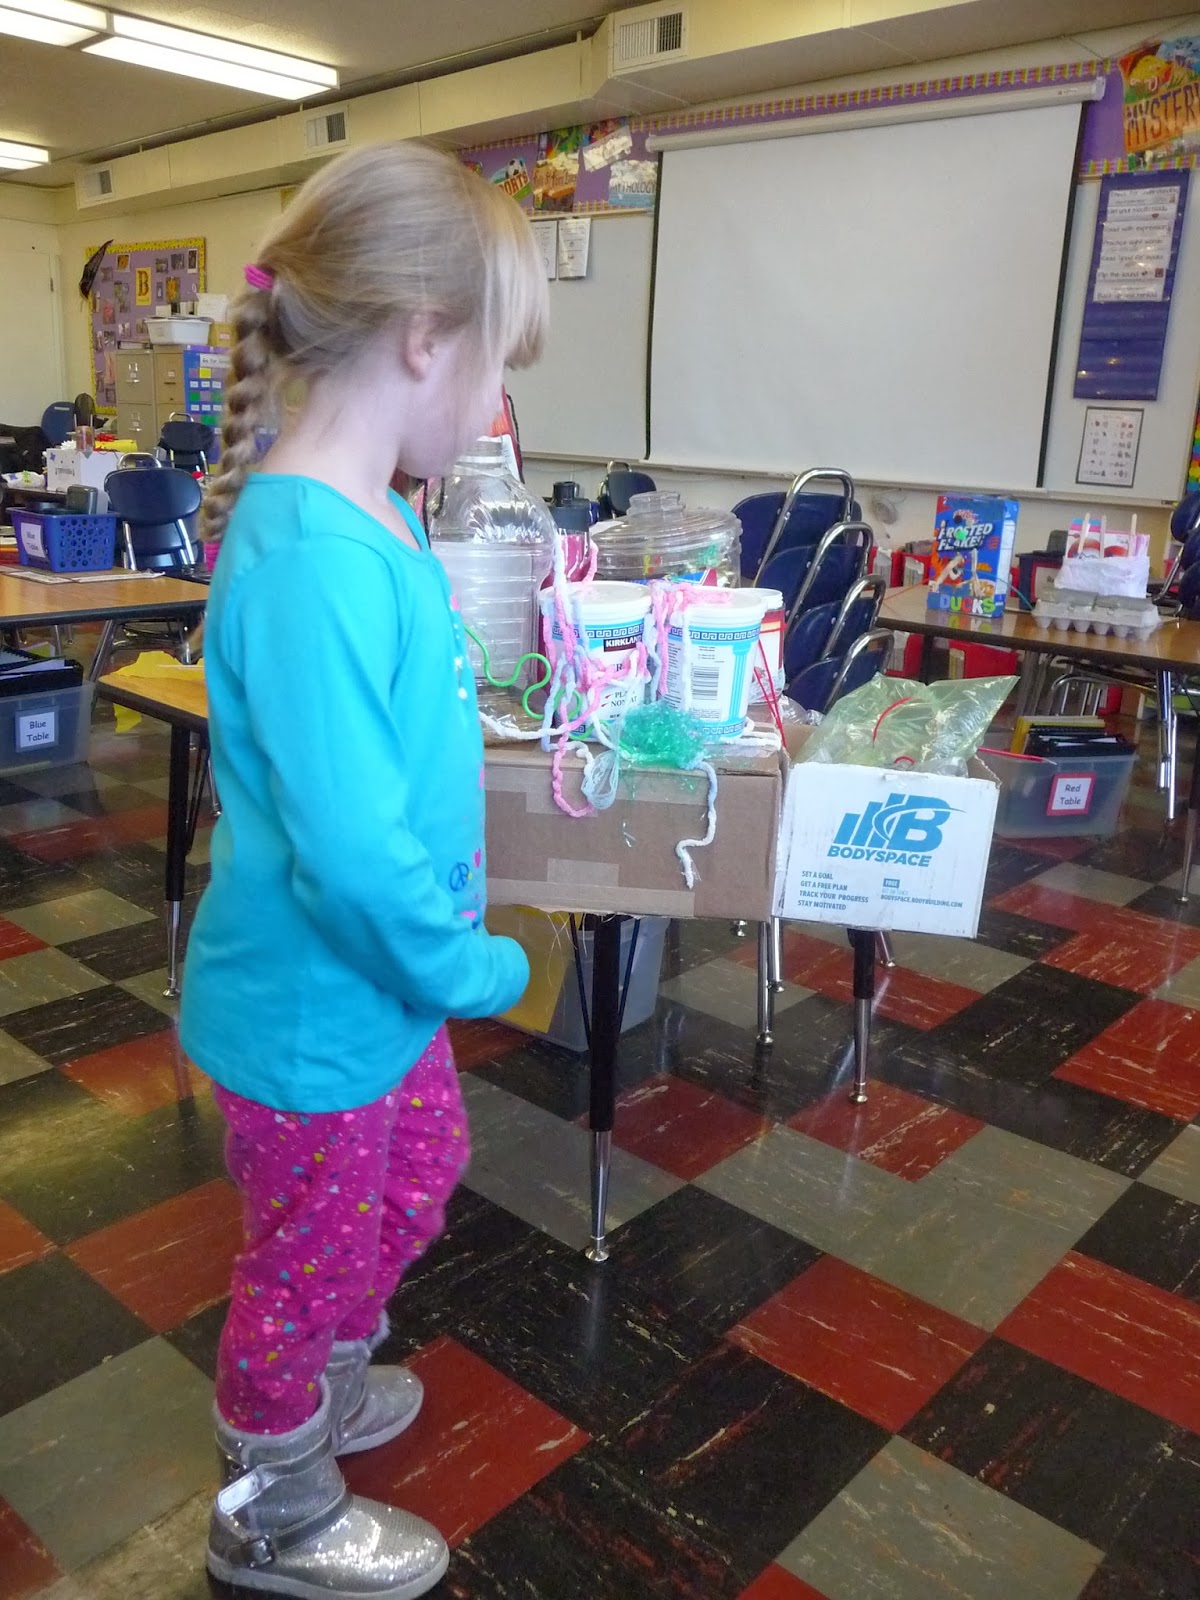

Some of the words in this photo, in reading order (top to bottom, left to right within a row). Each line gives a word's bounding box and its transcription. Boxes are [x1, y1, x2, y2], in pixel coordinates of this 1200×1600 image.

[138, 270, 149, 296] B
[940, 594, 996, 614] DUCKS
[29, 720, 47, 730] Blue
[26, 732, 50, 742] Table
[1065, 784, 1081, 792] Red
[1060, 797, 1081, 805] Table
[827, 845, 932, 867] BODYSPACE
[802, 870, 812, 878] SET
[818, 872, 834, 880] GOAL
[800, 880, 811, 888] GET
[832, 883, 848, 891] PLAN
[799, 890, 819, 898] TRACK
[820, 892, 836, 900] YOUR
[838, 893, 869, 903] PROGRESS
[813, 901, 847, 910] MOTIVATED
